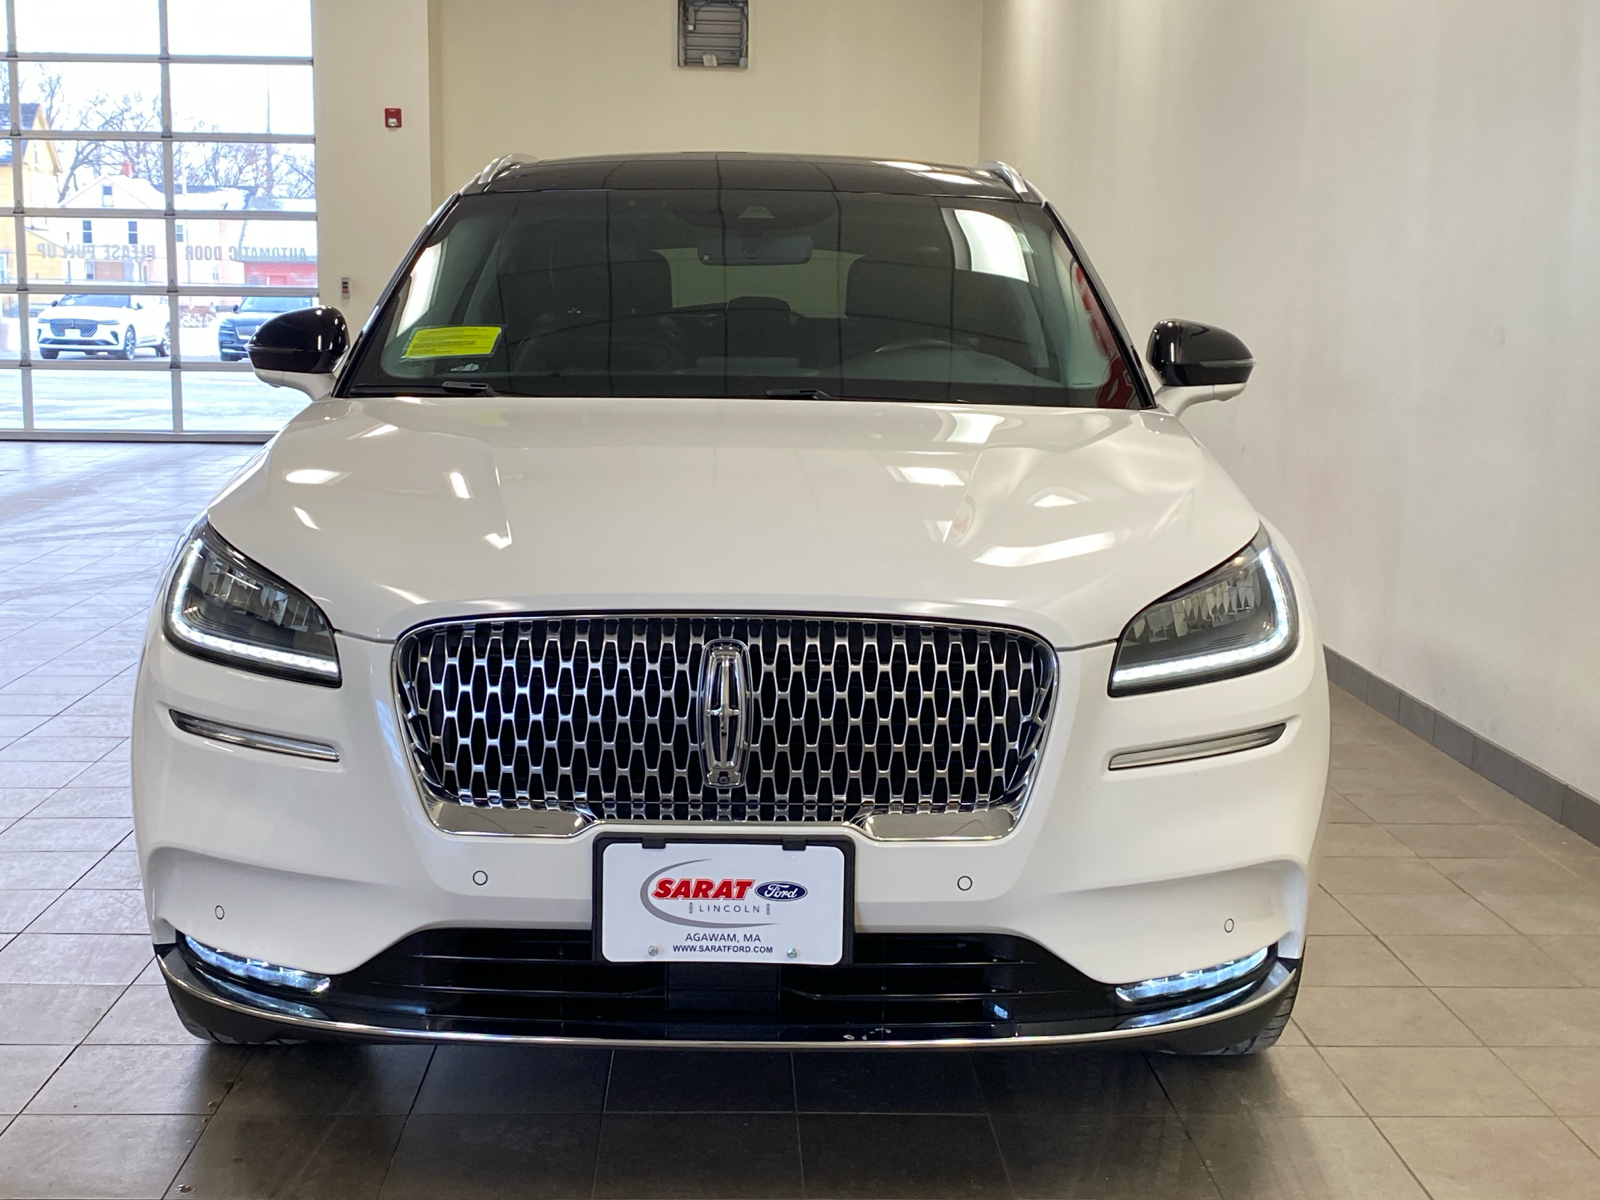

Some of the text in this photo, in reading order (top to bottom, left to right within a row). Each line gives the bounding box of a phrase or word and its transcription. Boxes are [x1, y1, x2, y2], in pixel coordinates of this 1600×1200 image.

[651, 877, 799, 901] SARAT Ford
[699, 904, 761, 914] LINCOLN
[684, 932, 761, 943] AGAWAM, MA
[672, 944, 774, 954] WWW.SARATFORD.COM
